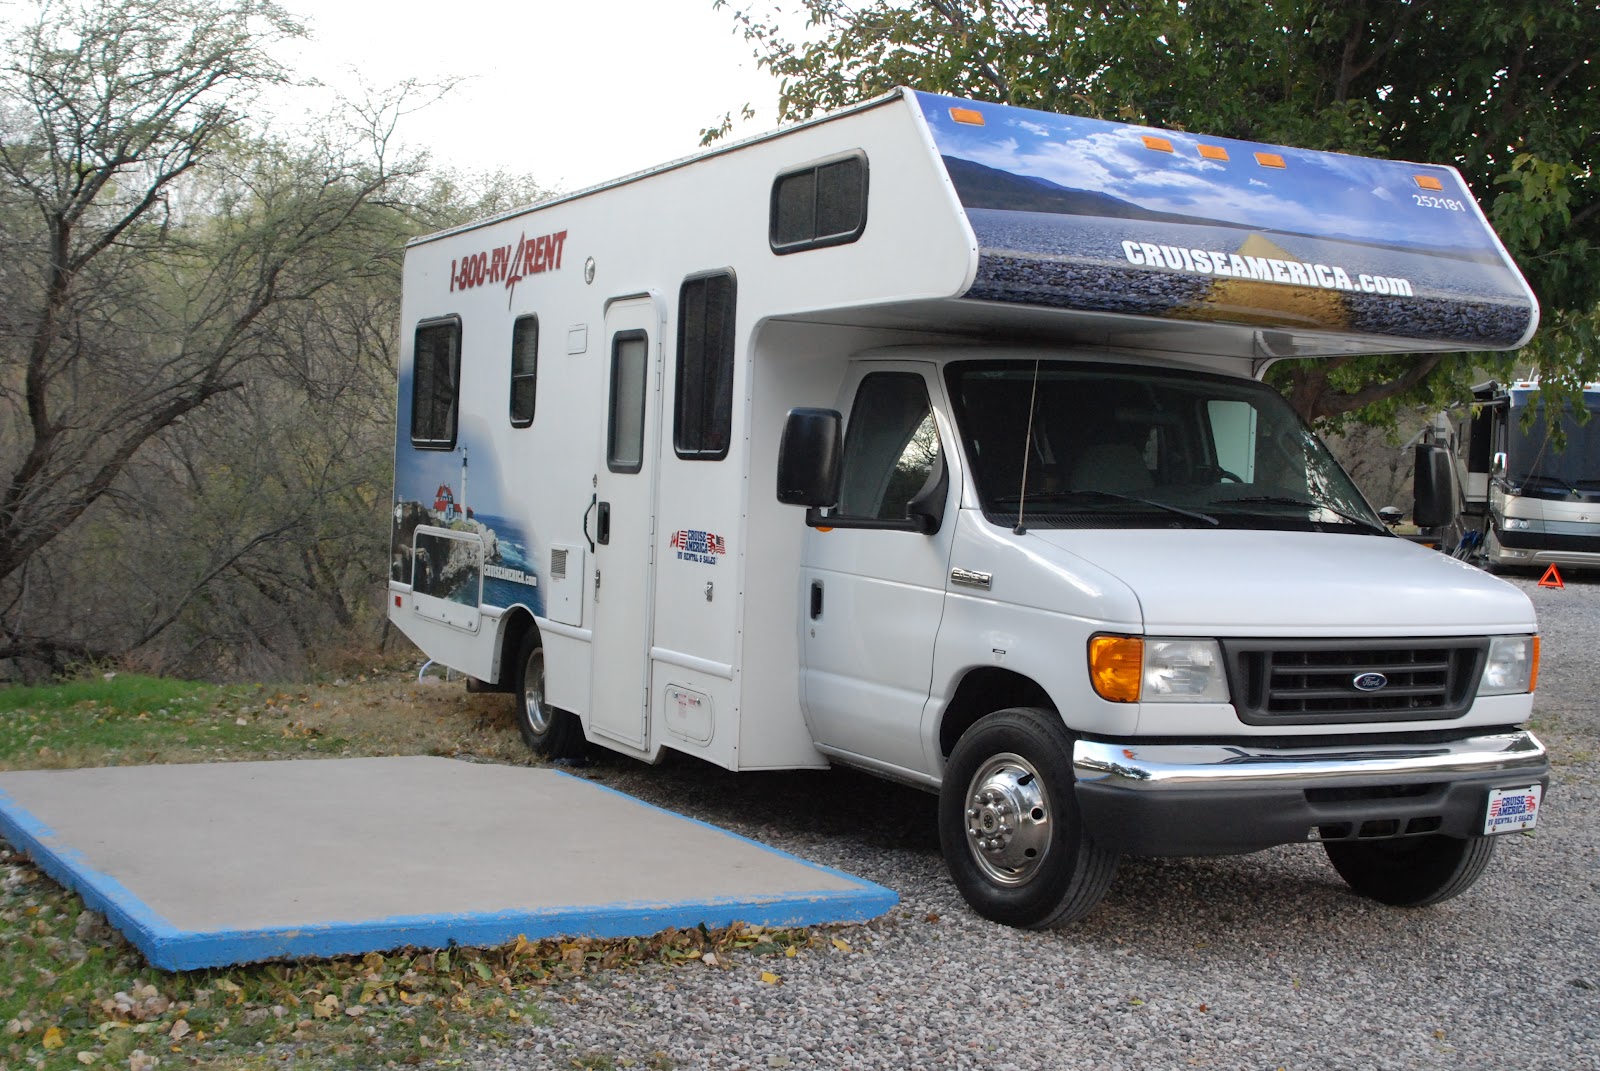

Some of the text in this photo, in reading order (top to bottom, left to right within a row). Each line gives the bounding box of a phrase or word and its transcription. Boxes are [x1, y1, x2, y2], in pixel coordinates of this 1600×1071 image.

[1412, 194, 1466, 212] 252181
[1121, 240, 1413, 297] CRUISEAMERICA.com
[687, 529, 707, 542] CRUISE
[685, 541, 708, 554] AMERICA
[677, 551, 683, 560] RV
[683, 552, 699, 563] RENTAL
[703, 555, 716, 565] SALES
[1362, 676, 1380, 687] Ford
[1501, 795, 1526, 807] CRUISE
[1497, 805, 1526, 817] AMERICA
[1494, 816, 1513, 826] RENTAL
[1518, 814, 1533, 823] SALES
